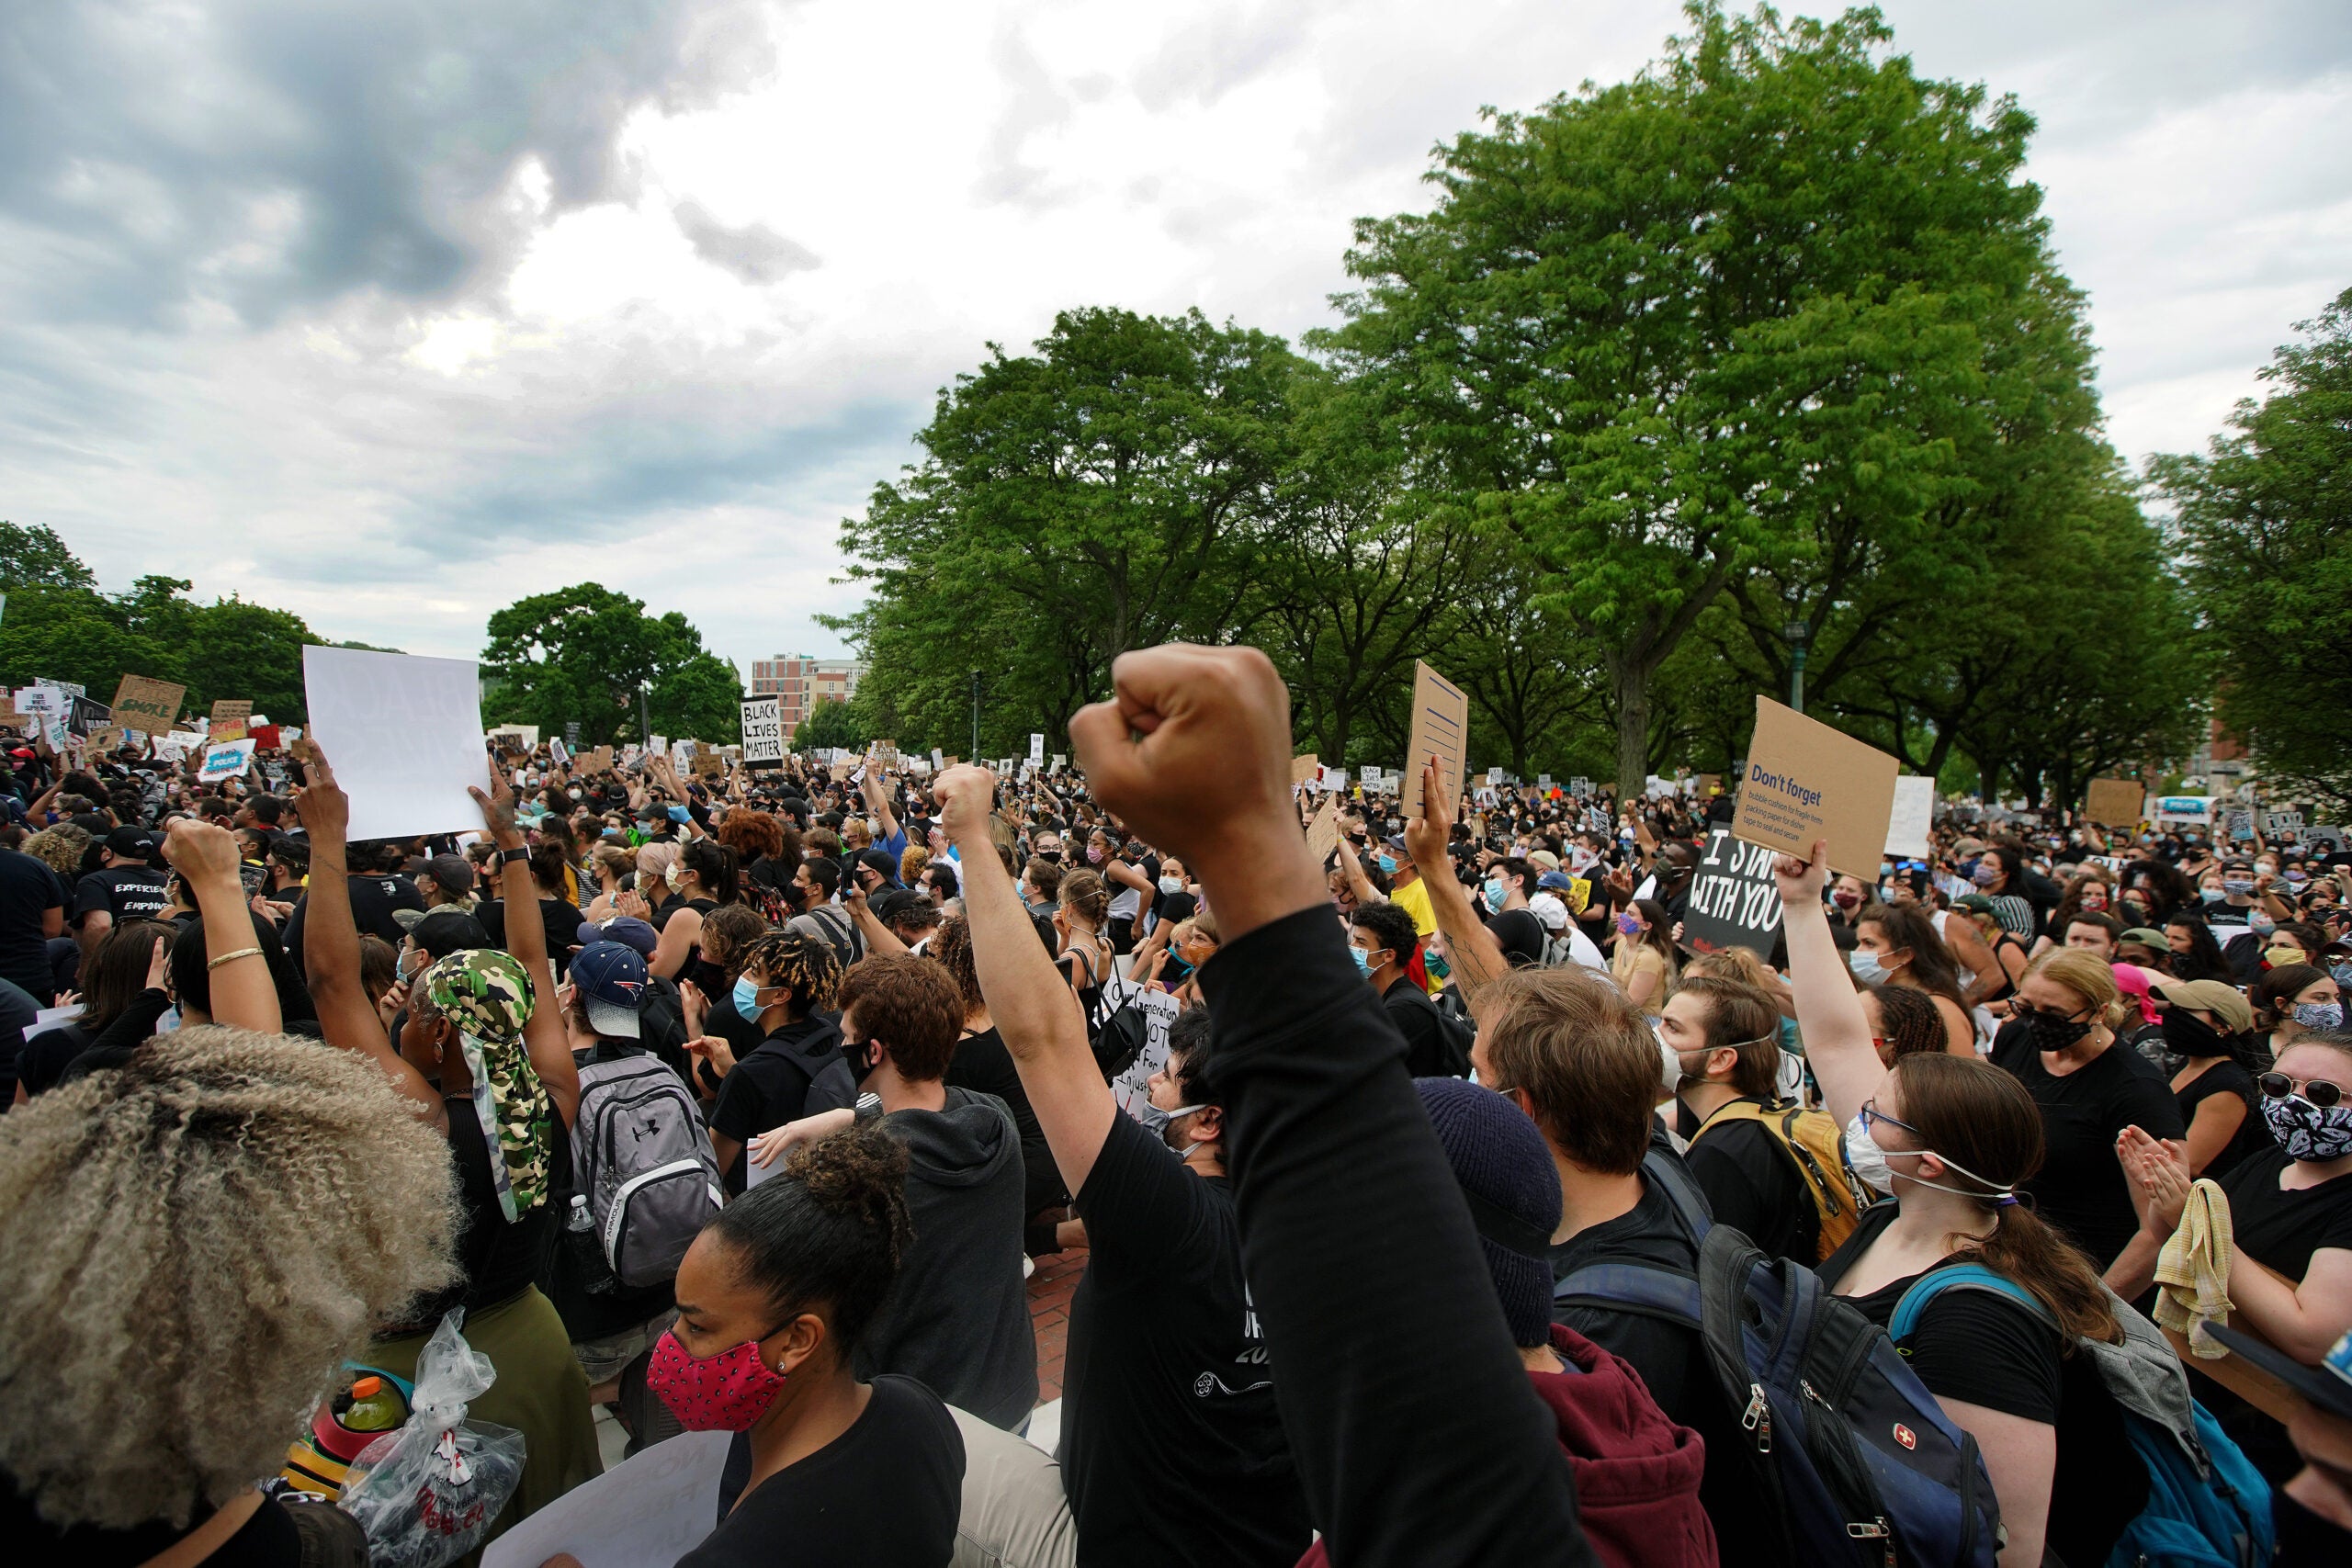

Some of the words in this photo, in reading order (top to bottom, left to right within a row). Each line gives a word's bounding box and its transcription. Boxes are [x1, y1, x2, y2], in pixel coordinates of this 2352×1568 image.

[118, 698, 170, 718] SMOKE
[744, 704, 777, 722] BLACK
[744, 724, 778, 738] LIVES
[213, 756, 239, 766] POLICE
[746, 740, 781, 759] MATTER
[1363, 766, 1379, 774] BLACK
[1751, 764, 1785, 792] Don't
[1786, 778, 1822, 807] forget
[1746, 804, 1766, 818] packing
[1767, 811, 1782, 822] paper
[1790, 819, 1805, 831] dishes
[1748, 791, 1768, 804] bubble
[1769, 798, 1787, 810] cushion
[1795, 808, 1810, 820] fragile
[1810, 816, 1823, 825] items
[1743, 816, 1757, 826] tape
[1757, 819, 1763, 828] to
[1763, 824, 1773, 832] seal
[1773, 827, 1783, 836] and
[1783, 831, 1800, 841] secure
[1703, 829, 1729, 865] I
[1729, 840, 1780, 881] STAN
[124, 901, 168, 910] EMPOW
[1690, 873, 1742, 920] WITH
[1738, 881, 1783, 932] YOU
[1135, 987, 1177, 1021] Generation
[1143, 1049, 1158, 1070] For
[1116, 1074, 1148, 1097] Injust
[606, 1199, 623, 1236] ARMOUR
